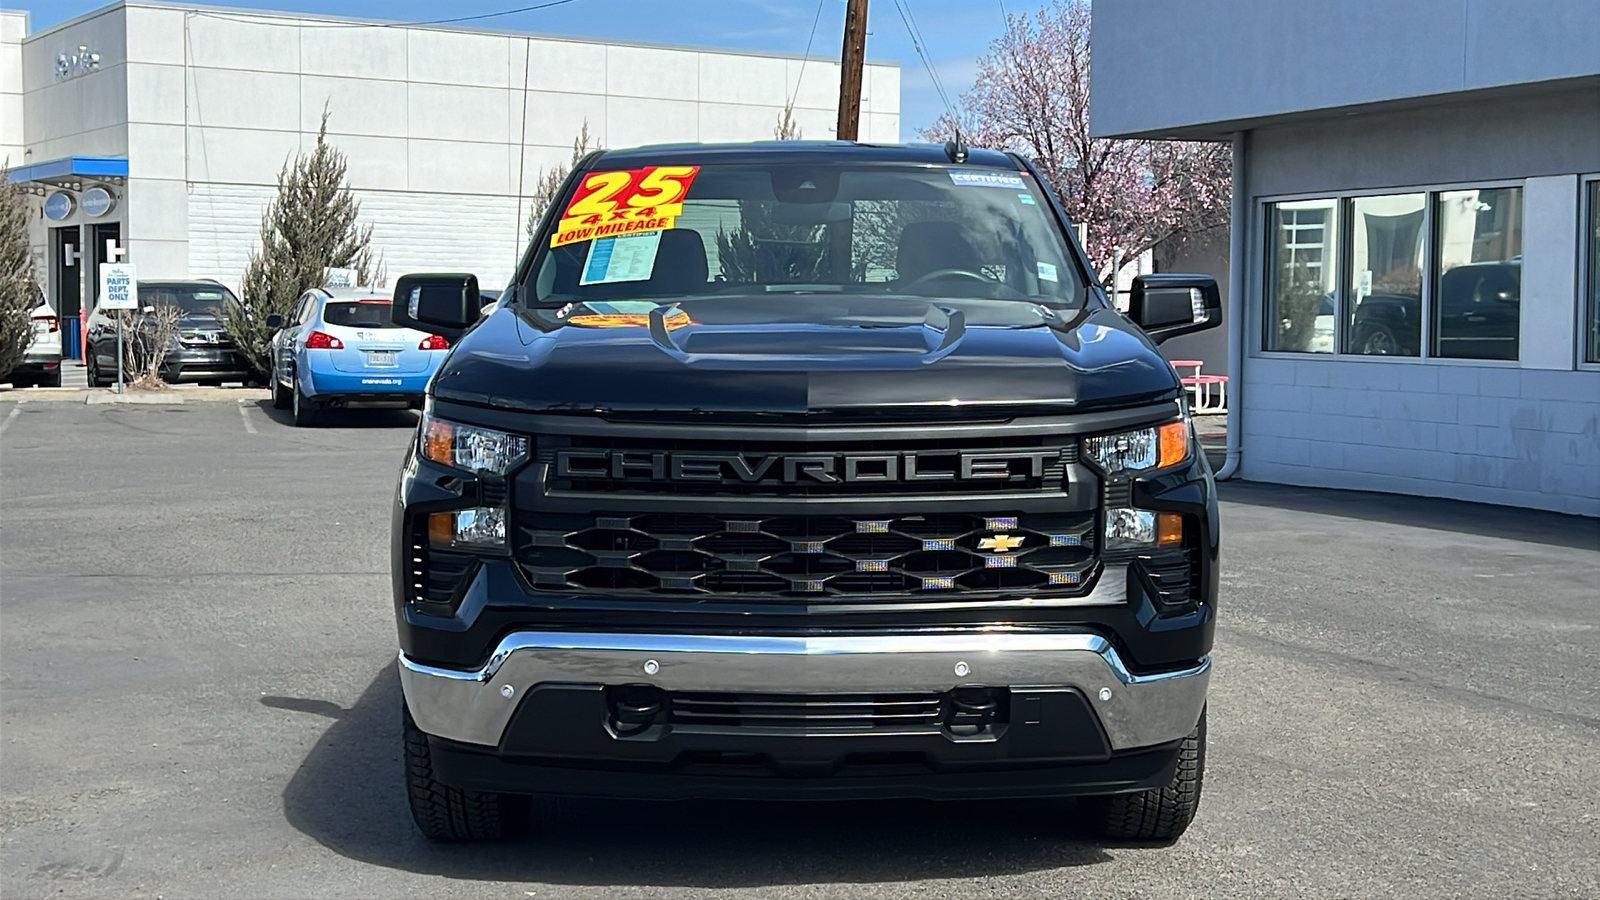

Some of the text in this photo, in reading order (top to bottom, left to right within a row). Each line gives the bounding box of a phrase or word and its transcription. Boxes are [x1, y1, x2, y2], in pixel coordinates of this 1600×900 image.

[567, 166, 696, 216] 25
[954, 174, 1020, 184] CERTIFIED
[556, 217, 669, 244] LOW MILEAGE
[108, 293, 129, 301] ONLY
[557, 449, 1061, 483] CHEVROLET
